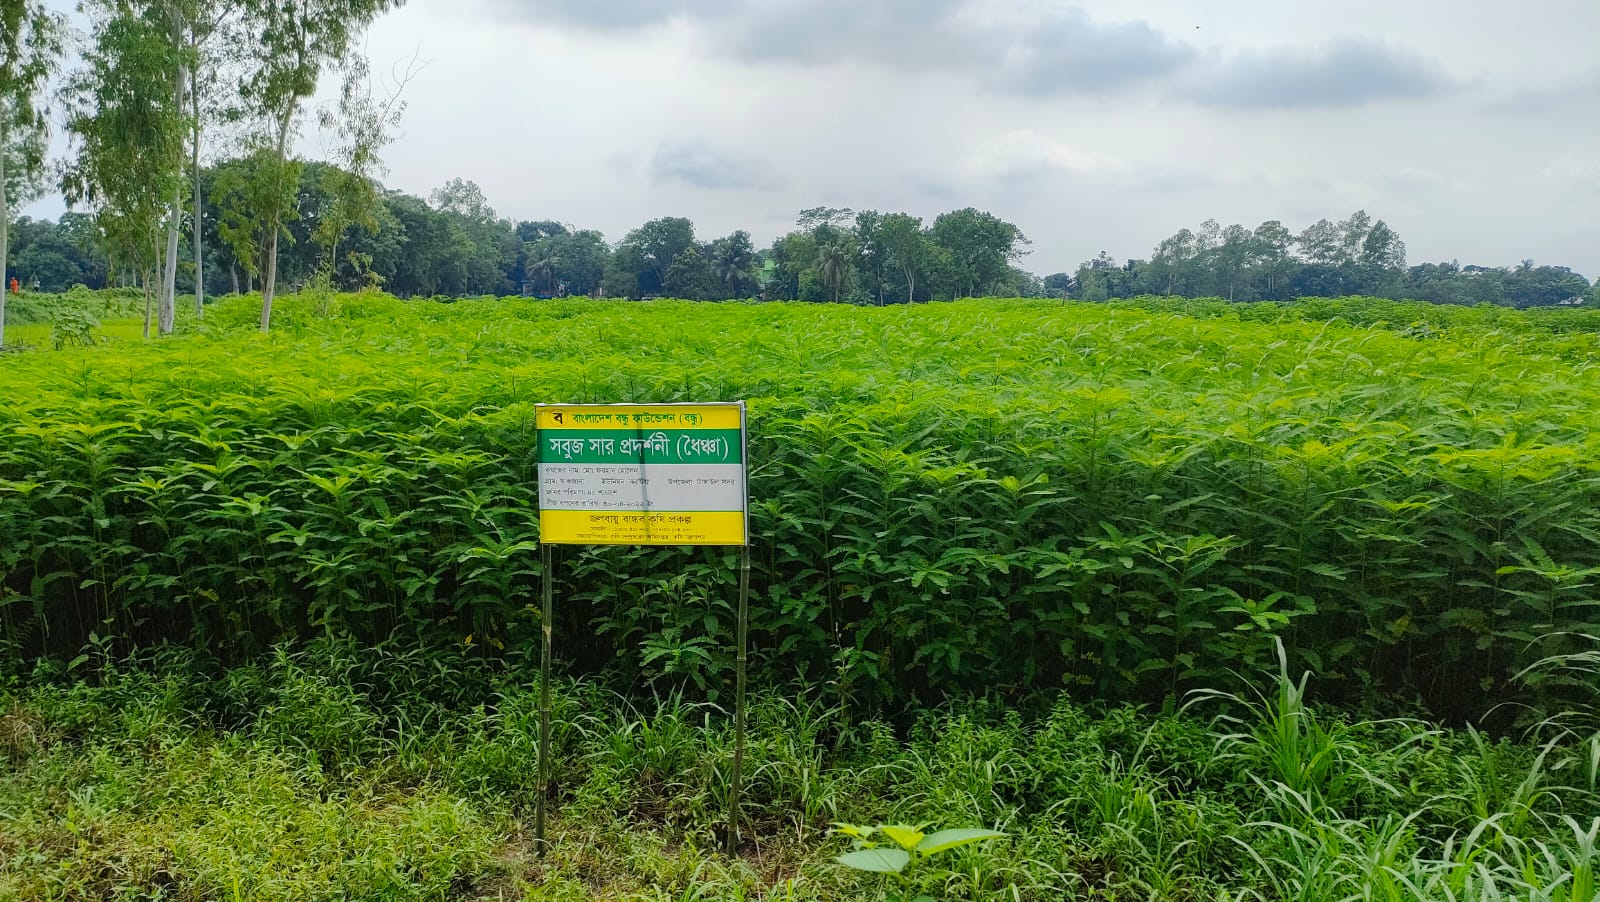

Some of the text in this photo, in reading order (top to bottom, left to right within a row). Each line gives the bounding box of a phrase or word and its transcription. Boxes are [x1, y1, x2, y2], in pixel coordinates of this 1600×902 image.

[571, 411, 702, 425] বাংলাদেশ বন্ধু ফাউন্ডেশন (বন্ধু)
[549, 432, 729, 461] সবুজ সার প্রদর্শনী (ধৈঞ্চা)
